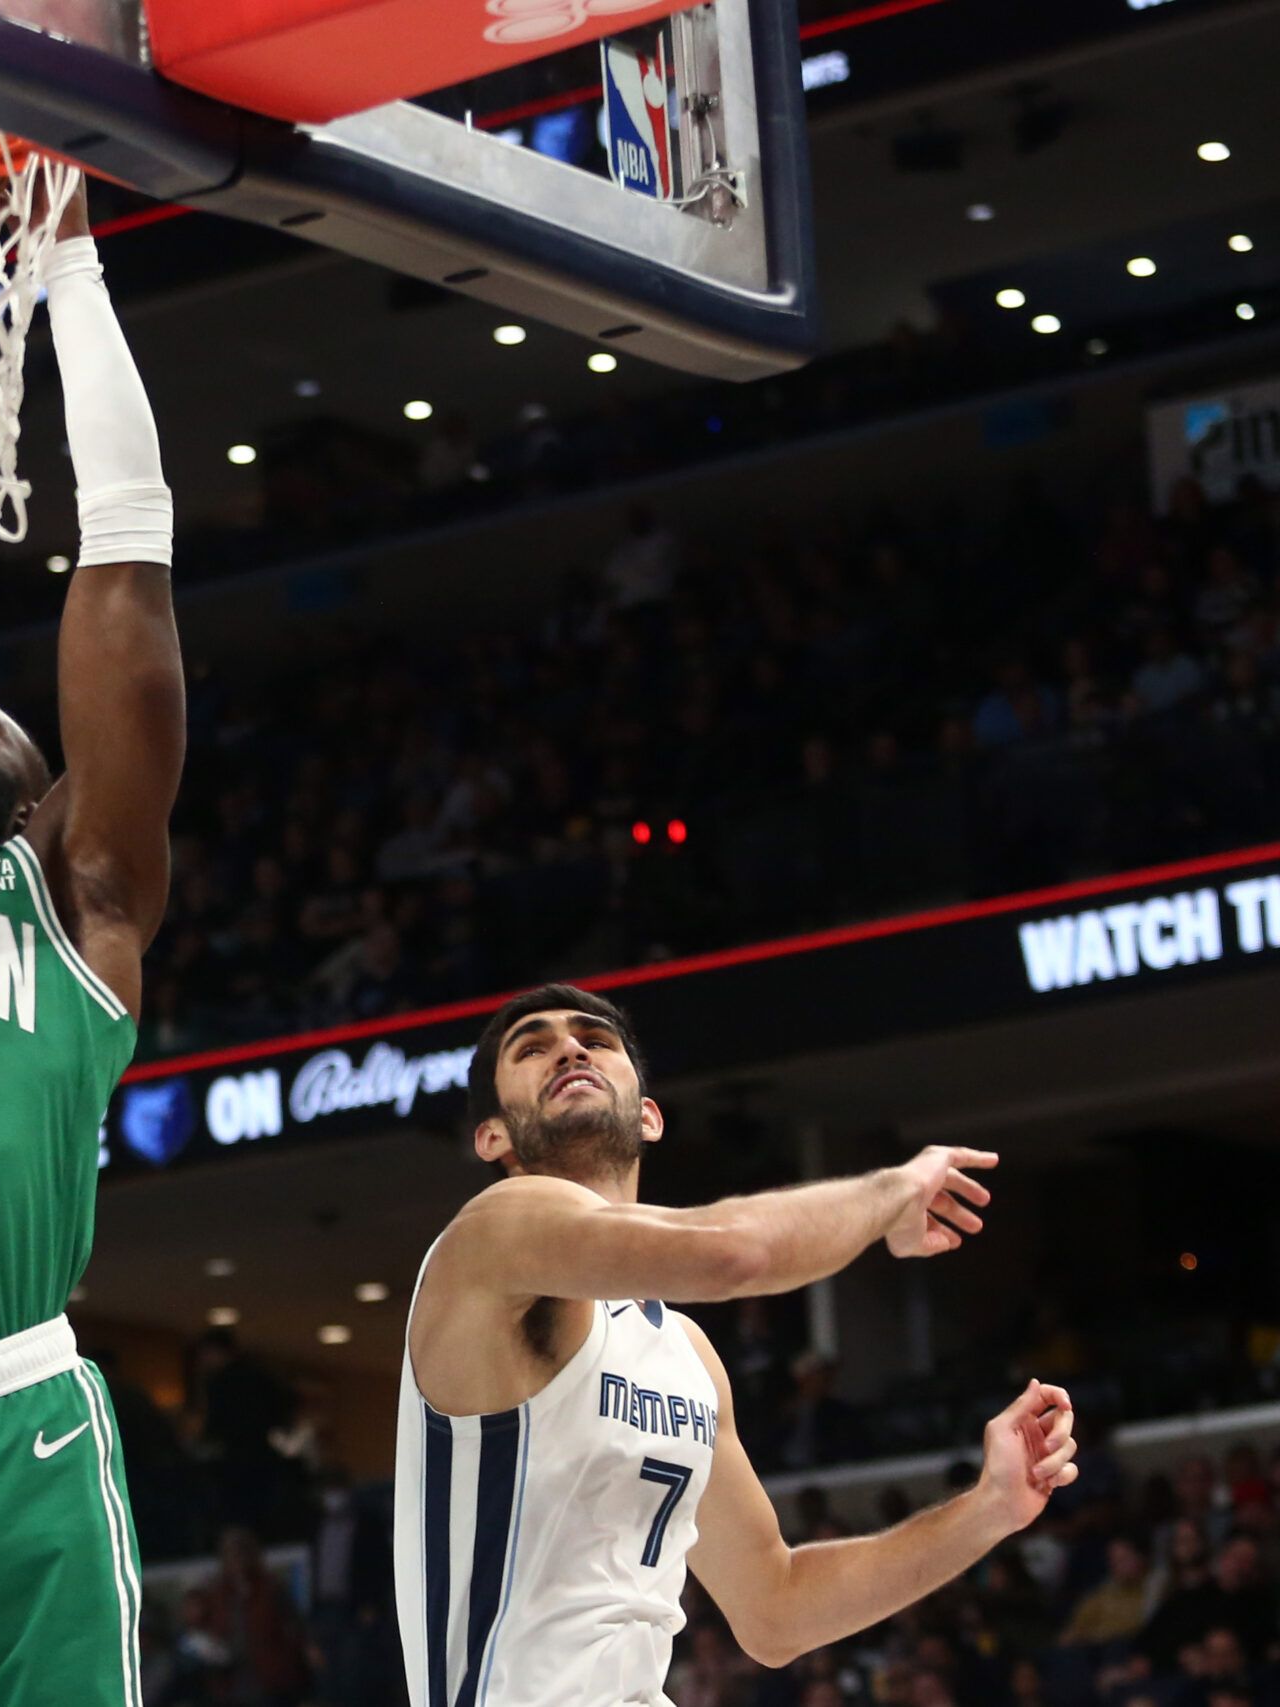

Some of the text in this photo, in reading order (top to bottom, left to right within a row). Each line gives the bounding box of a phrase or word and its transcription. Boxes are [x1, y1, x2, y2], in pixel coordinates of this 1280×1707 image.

[617, 138, 650, 186] NBA
[1018, 887, 1224, 993] WATCH
[206, 1068, 282, 1146] ON
[289, 1041, 419, 1118] Bally
[639, 1456, 694, 1568] 7
